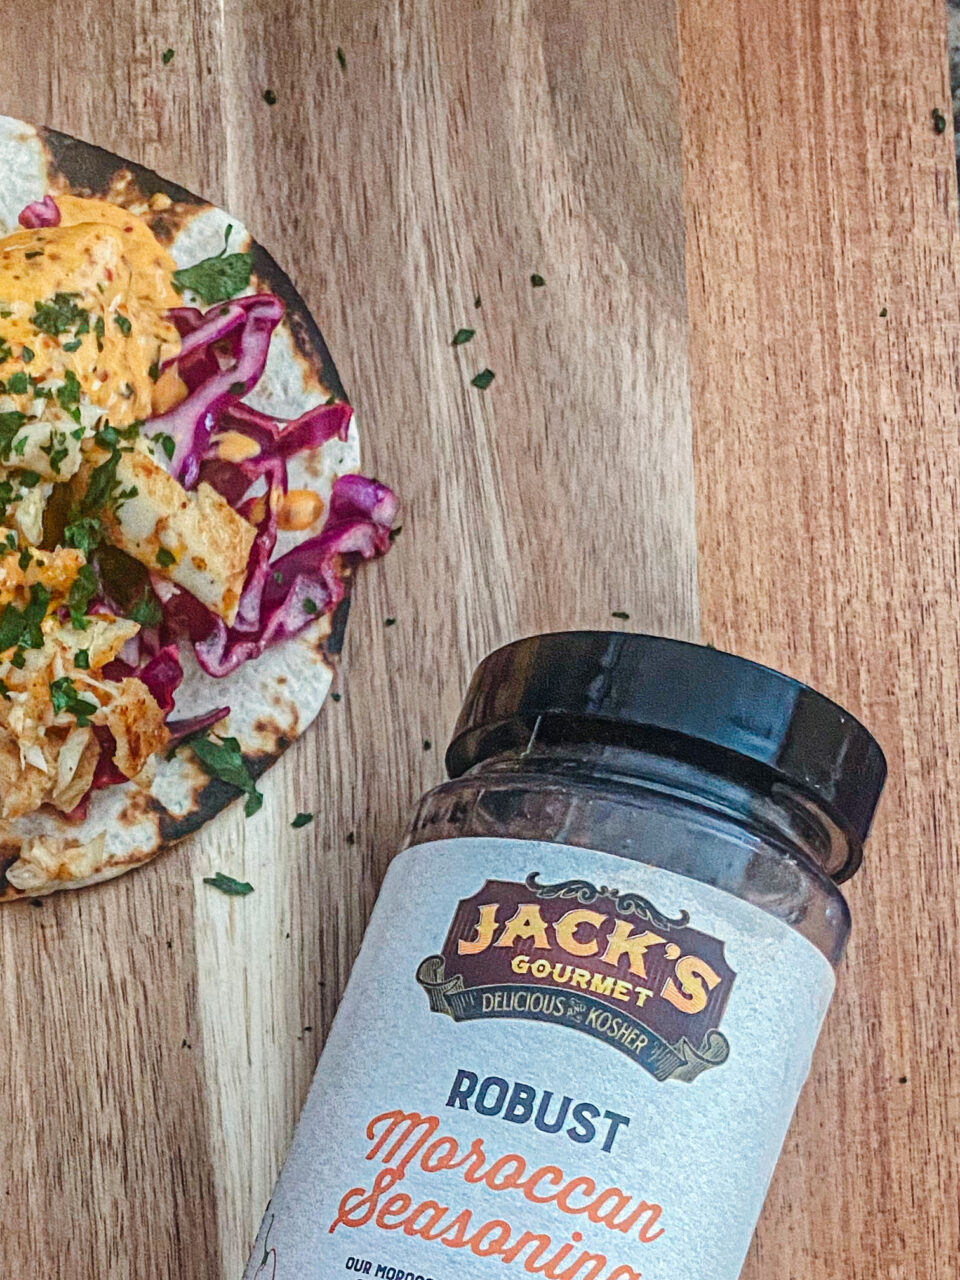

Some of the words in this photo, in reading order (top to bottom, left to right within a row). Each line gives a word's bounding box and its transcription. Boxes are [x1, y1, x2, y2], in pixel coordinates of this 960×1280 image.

[458, 904, 721, 1015] JACK'S
[511, 955, 653, 1008] GOURMET
[482, 992, 564, 1016] DELICIOUS
[587, 1007, 648, 1051] KOSHER
[445, 1069, 630, 1153] ROBUST
[365, 1110, 665, 1243] Moroccan
[345, 1256, 371, 1274] OUR
